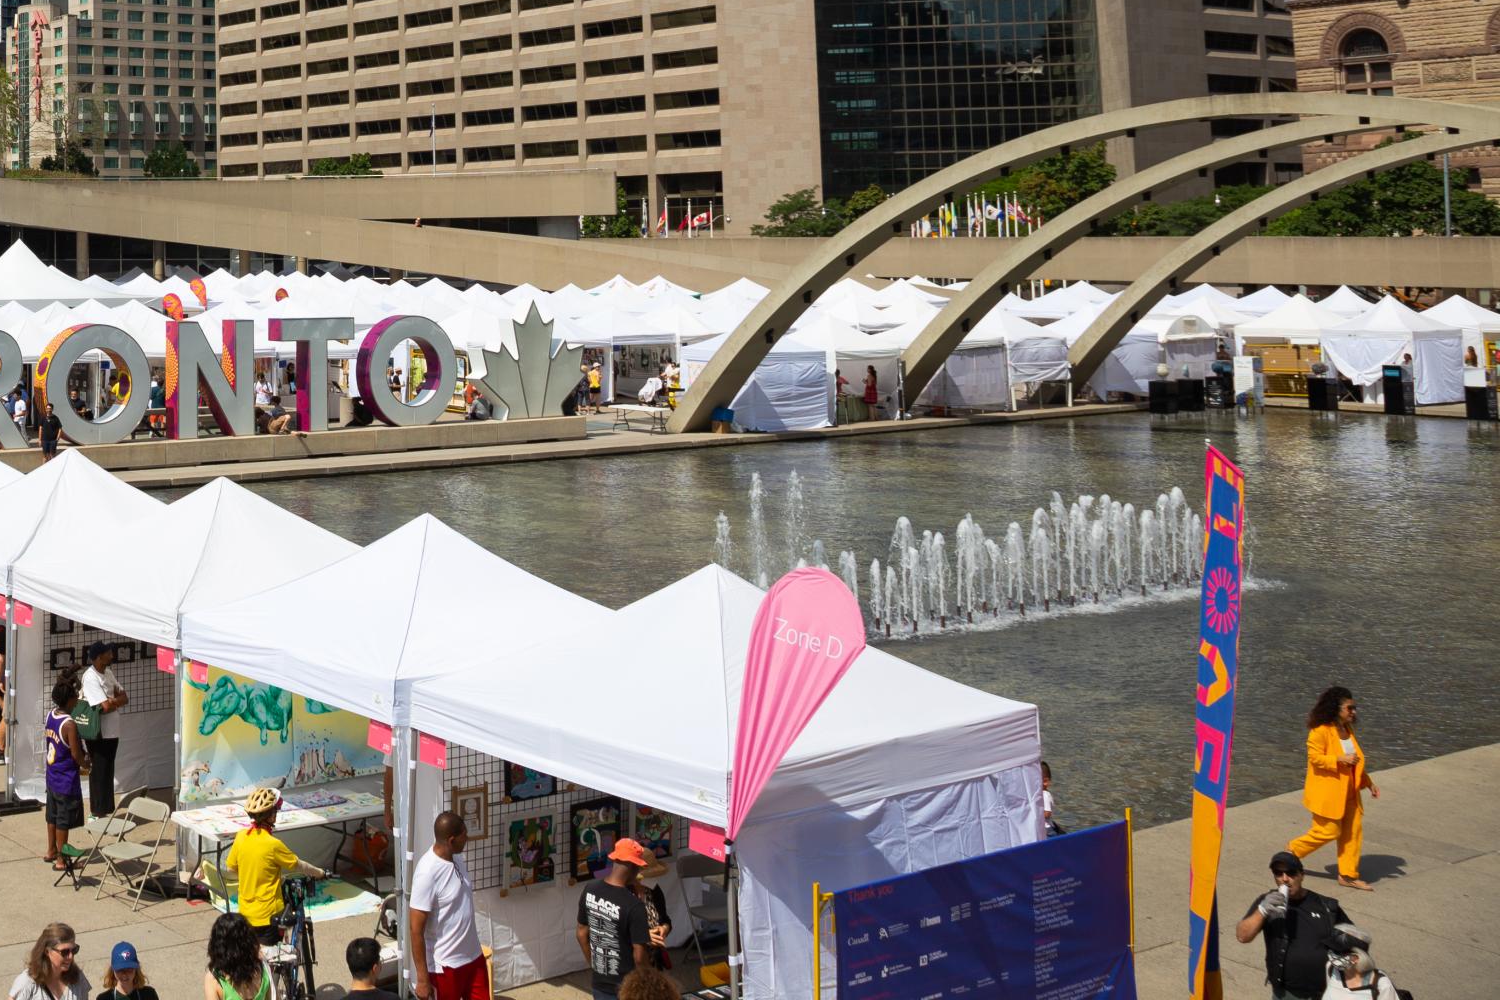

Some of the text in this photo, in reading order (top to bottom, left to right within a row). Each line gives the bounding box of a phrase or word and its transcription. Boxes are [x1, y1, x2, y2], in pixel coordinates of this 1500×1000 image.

[773, 616, 843, 659] Zone D
[586, 892, 620, 915] BLACK
